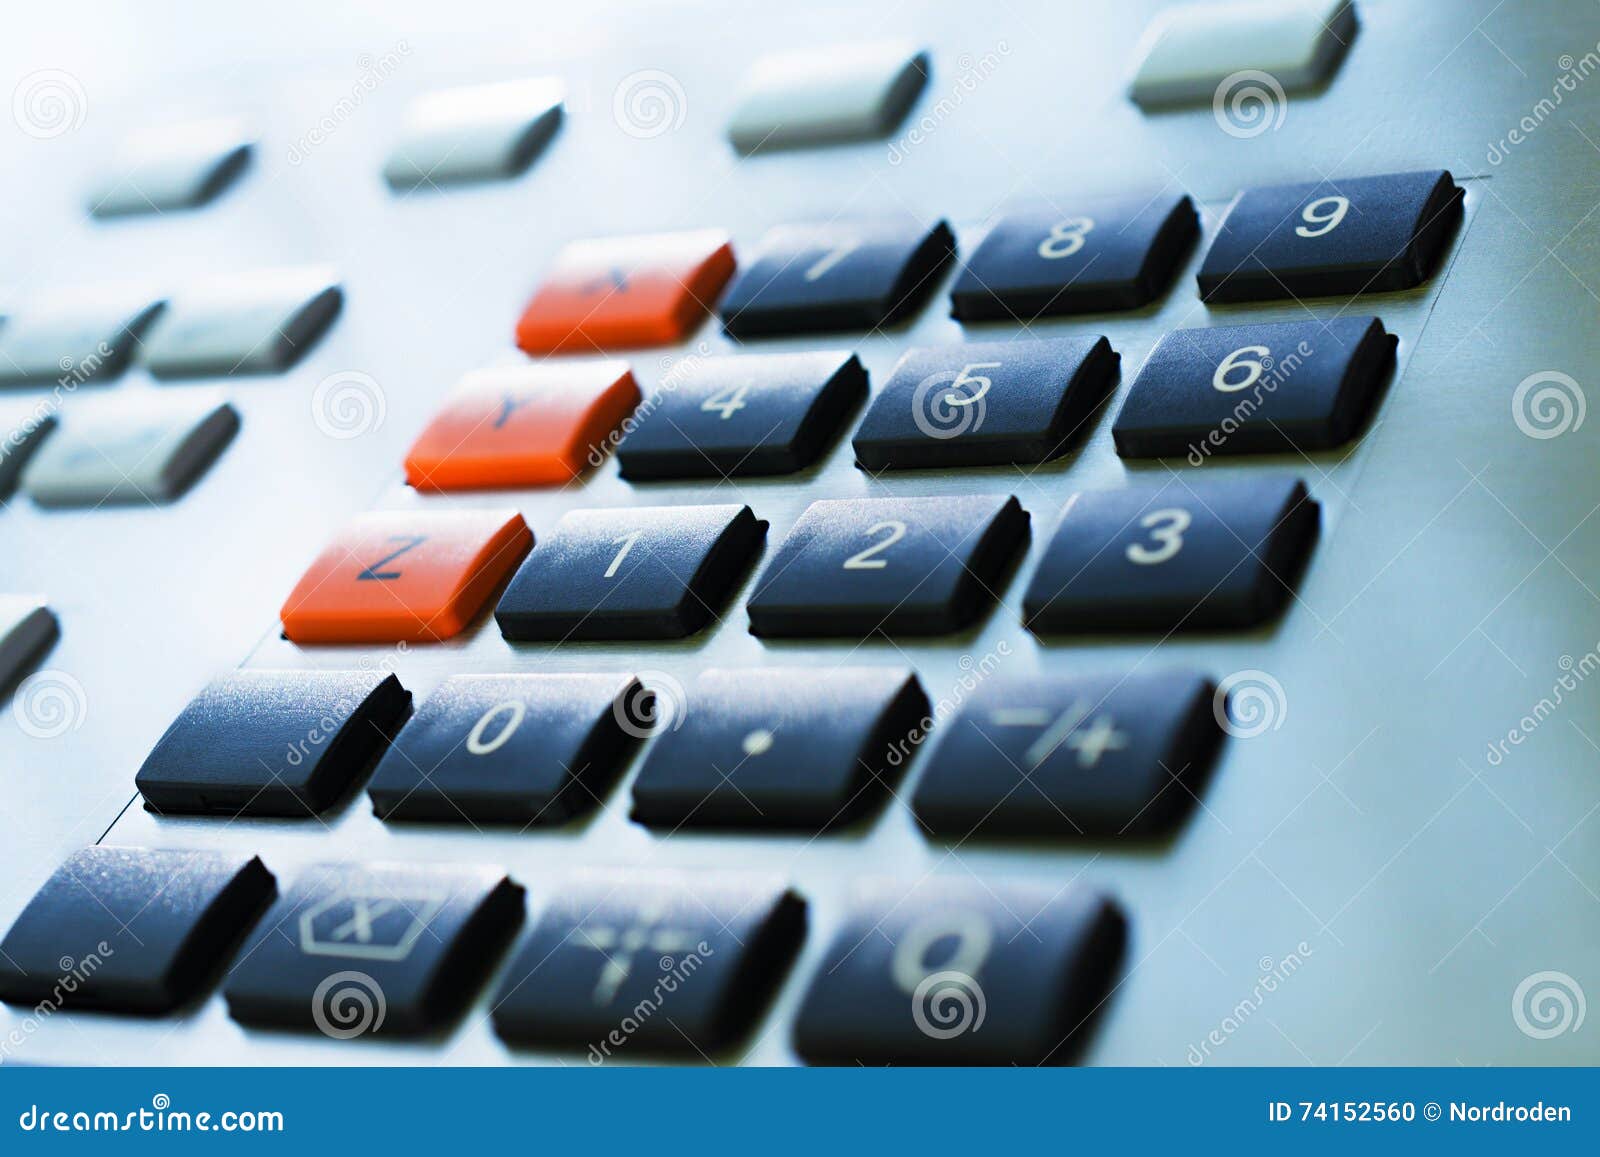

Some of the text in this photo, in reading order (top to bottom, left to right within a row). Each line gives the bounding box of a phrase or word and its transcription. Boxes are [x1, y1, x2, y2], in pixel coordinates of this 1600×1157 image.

[1038, 217, 1095, 260] 8
[1295, 196, 1349, 238] 9
[945, 362, 1001, 406] 5
[1212, 345, 1271, 392] 6
[701, 379, 752, 419] 4
[356, 535, 430, 580] Z
[603, 531, 642, 578] 1
[843, 520, 907, 569] 2
[1126, 508, 1192, 564] 3
[466, 702, 525, 755] 0
